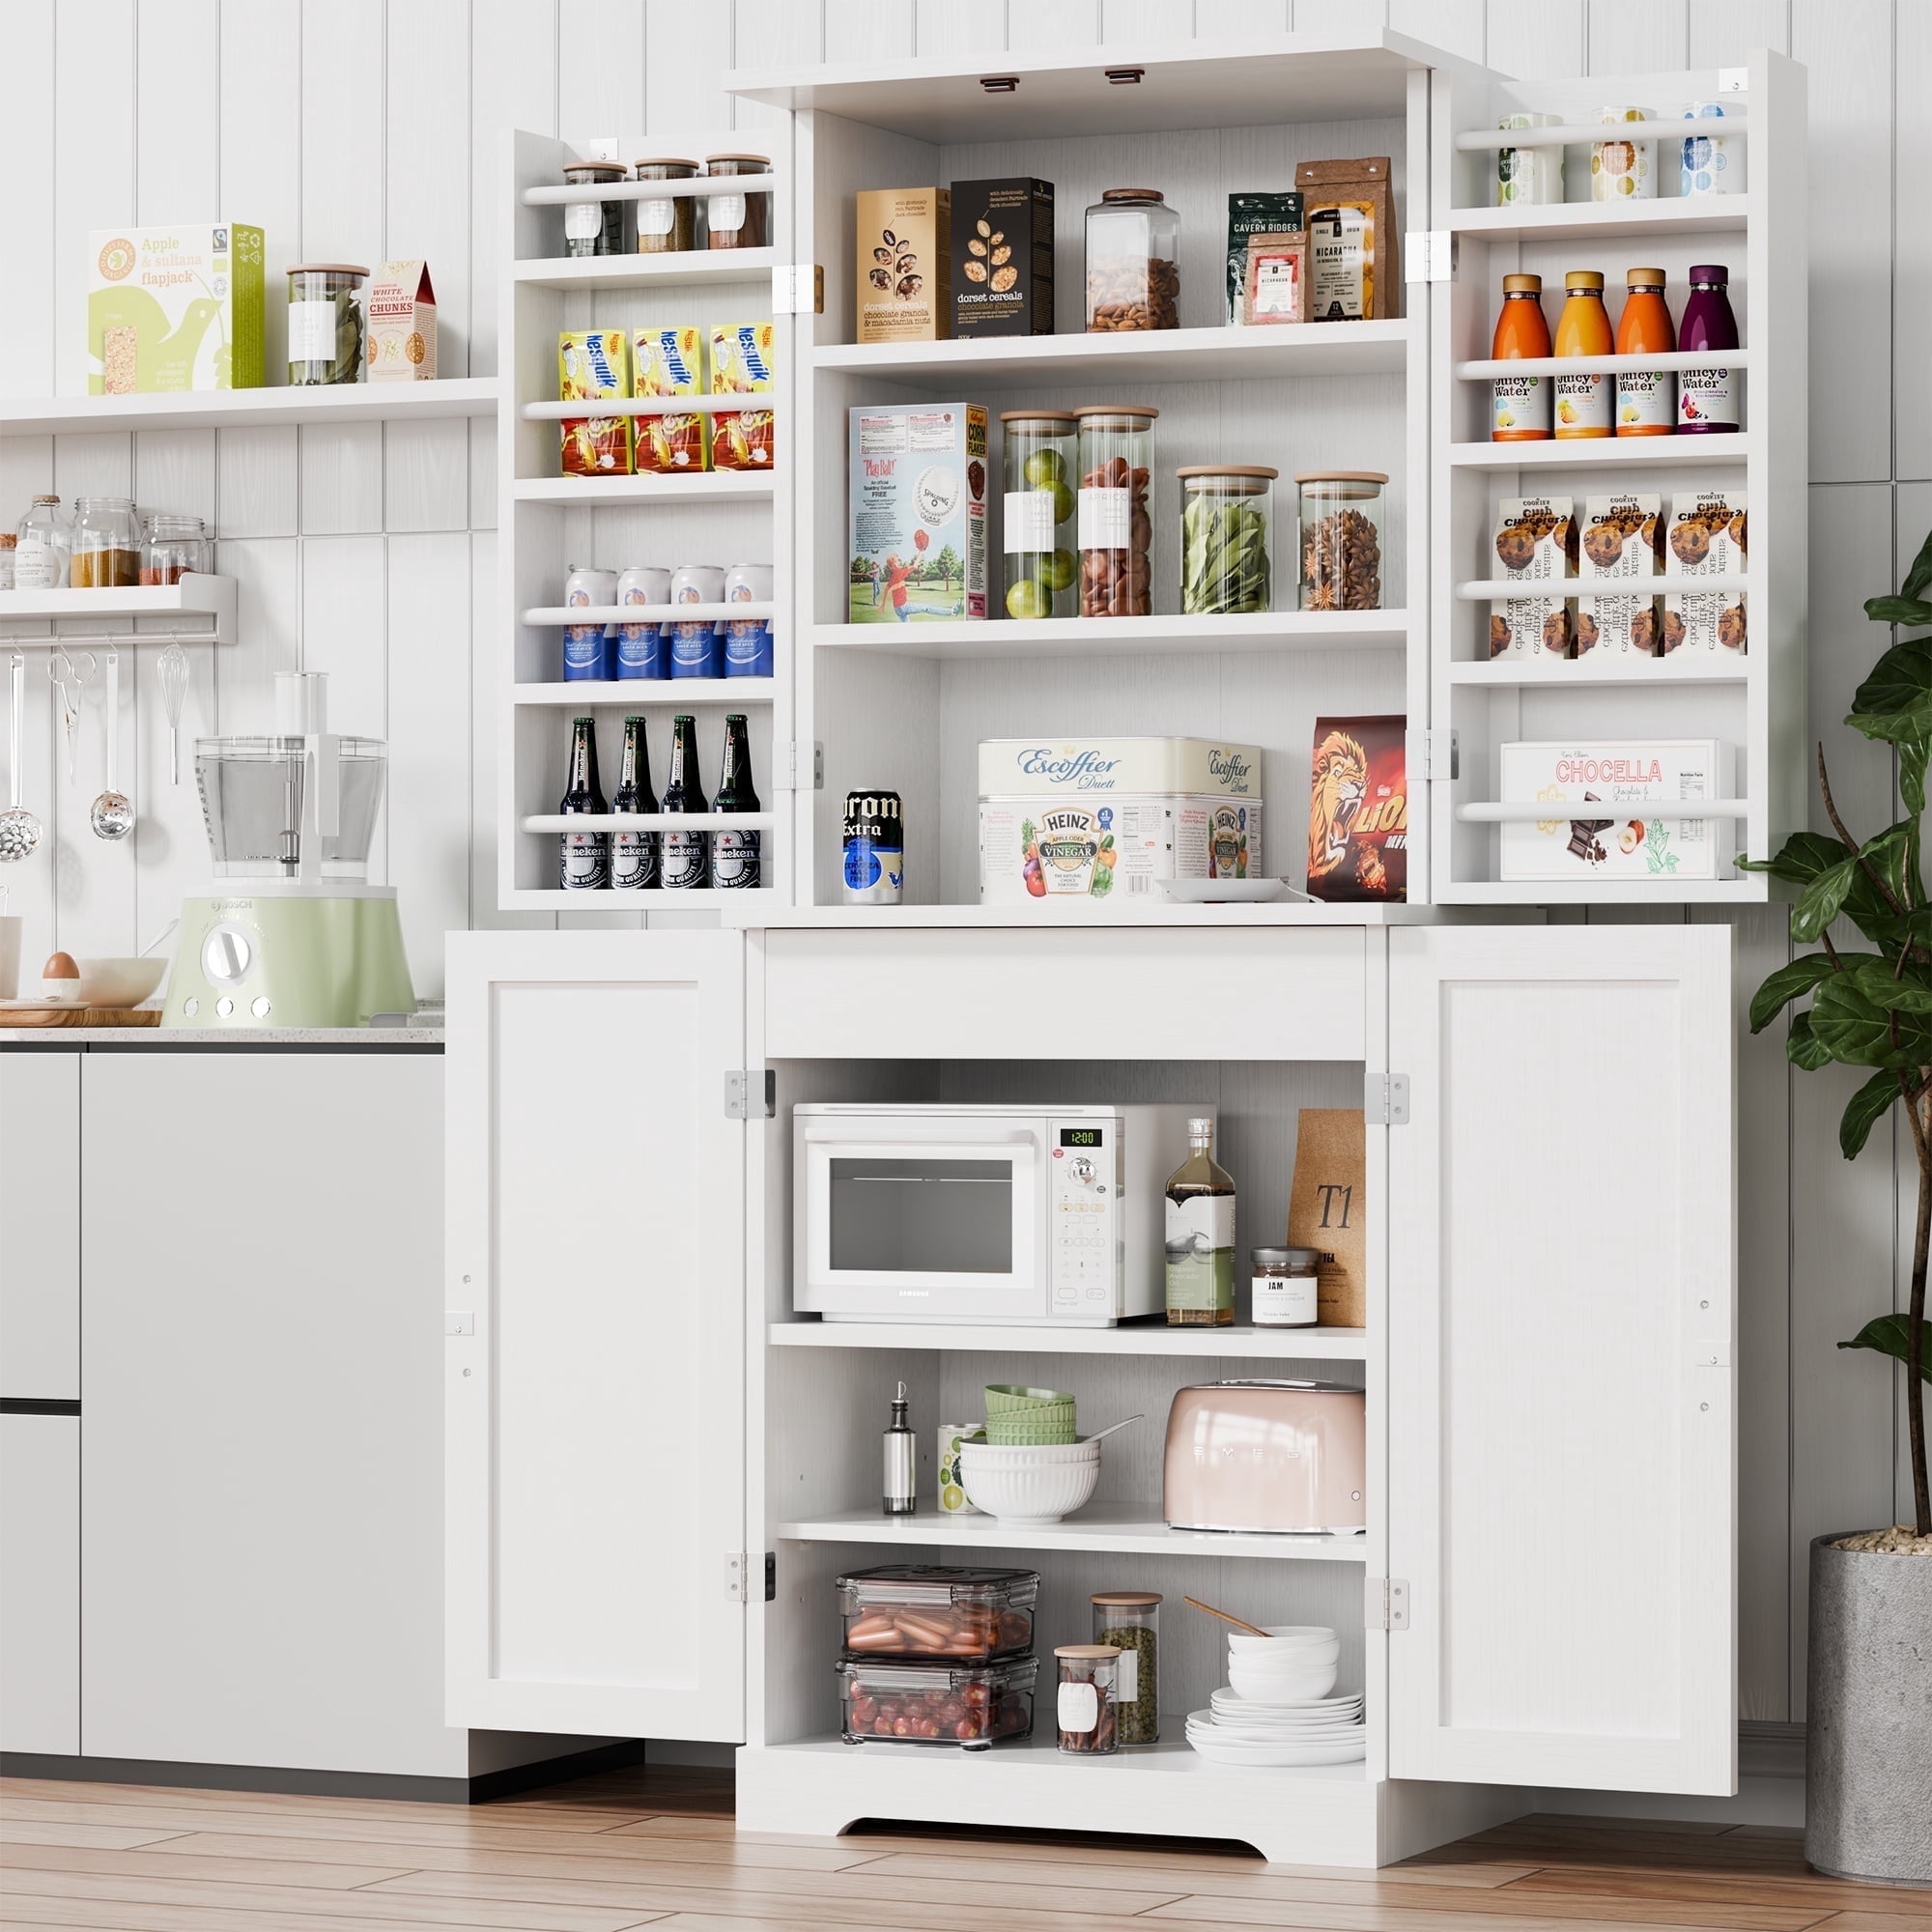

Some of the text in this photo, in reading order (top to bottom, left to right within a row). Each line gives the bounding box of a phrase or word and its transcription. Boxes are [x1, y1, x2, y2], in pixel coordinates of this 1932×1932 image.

[1235, 223, 1297, 233] CAVERN RIDGES
[141, 237, 179, 252] Apple
[141, 254, 202, 268] & sultana
[141, 270, 192, 287] flapjack
[957, 291, 1023, 302] dorset cereals
[370, 302, 413, 313] CHUNKS
[865, 300, 927, 311] dorset cereals
[995, 300, 1025, 311] granola
[900, 309, 928, 319] granola
[587, 334, 617, 388] Nesquik
[662, 330, 692, 384] Nesquik
[739, 327, 770, 382] Nesquik
[1558, 374, 1591, 386] Juicy
[1620, 371, 1653, 383] Juicy
[1683, 369, 1717, 381] Juicy
[1495, 377, 1528, 388] Juicy
[1557, 384, 1593, 395] Water
[1620, 381, 1656, 392] Water
[1683, 378, 1719, 389] Water
[1495, 386, 1531, 397] Water
[968, 423, 985, 442] CORN
[968, 441, 985, 455] FLAKES
[923, 489, 950, 506] SPALDING
[1017, 750, 1122, 782] Escoffier
[1208, 750, 1251, 784] Escoffier
[1556, 759, 1662, 783] CHOCELLA
[1077, 774, 1116, 789] Duett
[1231, 778, 1248, 792] Duett
[1613, 785, 1642, 796] Chocolate
[843, 797, 903, 819] ron
[1047, 814, 1090, 831] HEINZ
[1217, 813, 1236, 830] HEINZ
[1045, 848, 1092, 857] VINEGAR
[1216, 846, 1236, 856] VINEGAR
[581, 867, 602, 883] QUALITY
[625, 866, 646, 883] QUALITY
[676, 866, 697, 883] QUALITY
[729, 868, 752, 886] QUALITY
[1072, 1132, 1094, 1144] 12:00
[1317, 1184, 1352, 1229] T1
[1322, 1253, 1334, 1264] TEA
[1268, 1282, 1283, 1291] JAM
